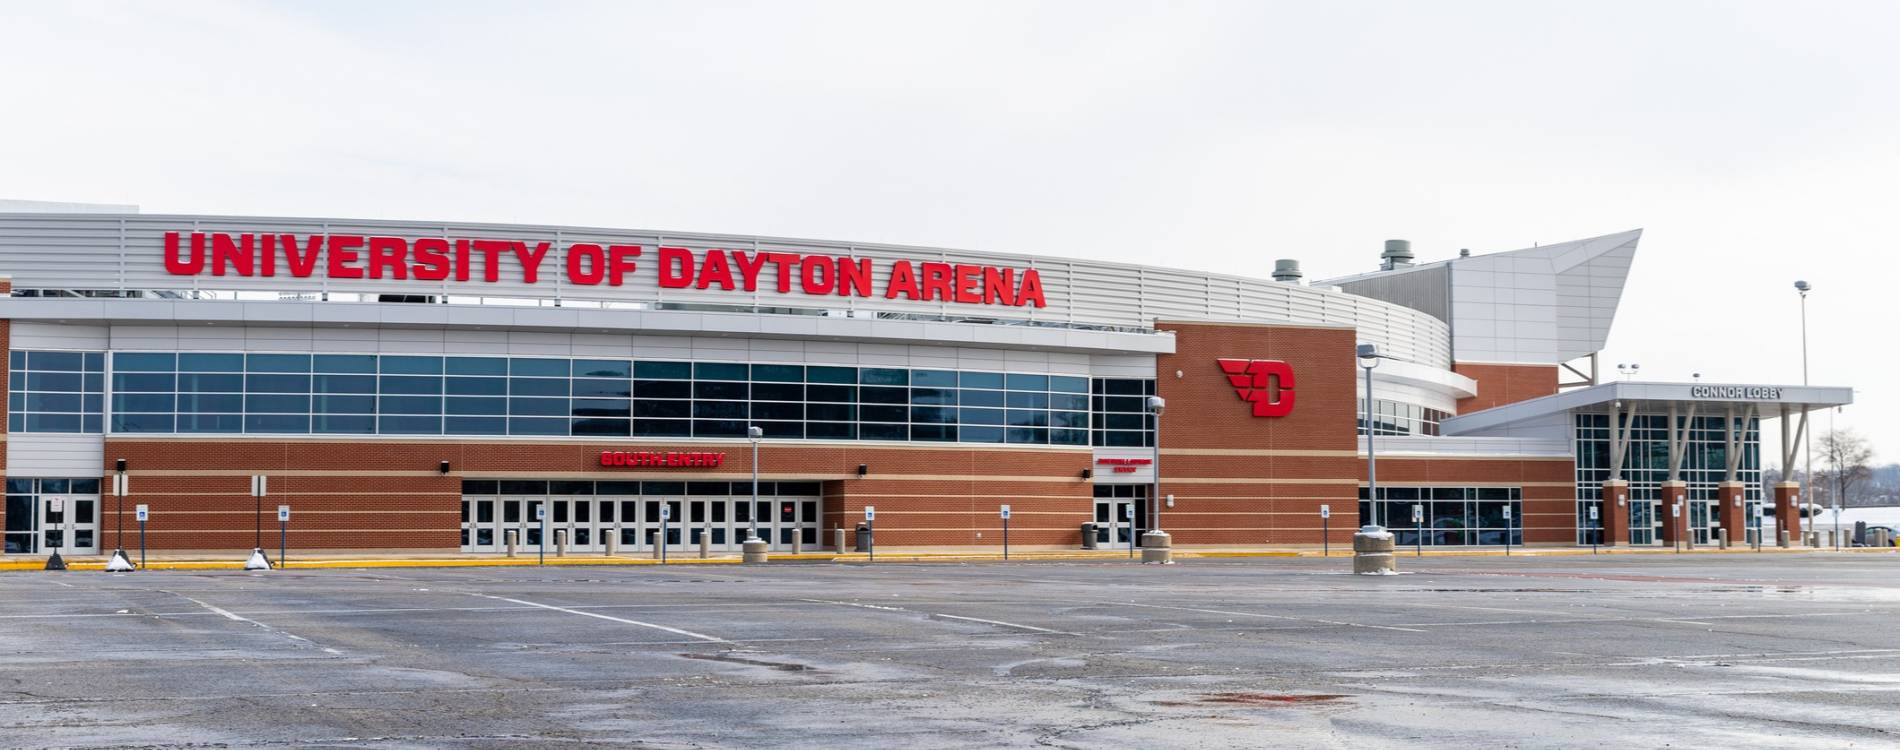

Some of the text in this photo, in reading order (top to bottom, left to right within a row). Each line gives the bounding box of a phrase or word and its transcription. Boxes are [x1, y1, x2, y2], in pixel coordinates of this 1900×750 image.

[163, 231, 1047, 309] UNIVERSITY OF DAYTON ARENA
[1691, 386, 1784, 400] CONNOR LOBBY
[600, 451, 727, 467] SOUTH ENTRY
